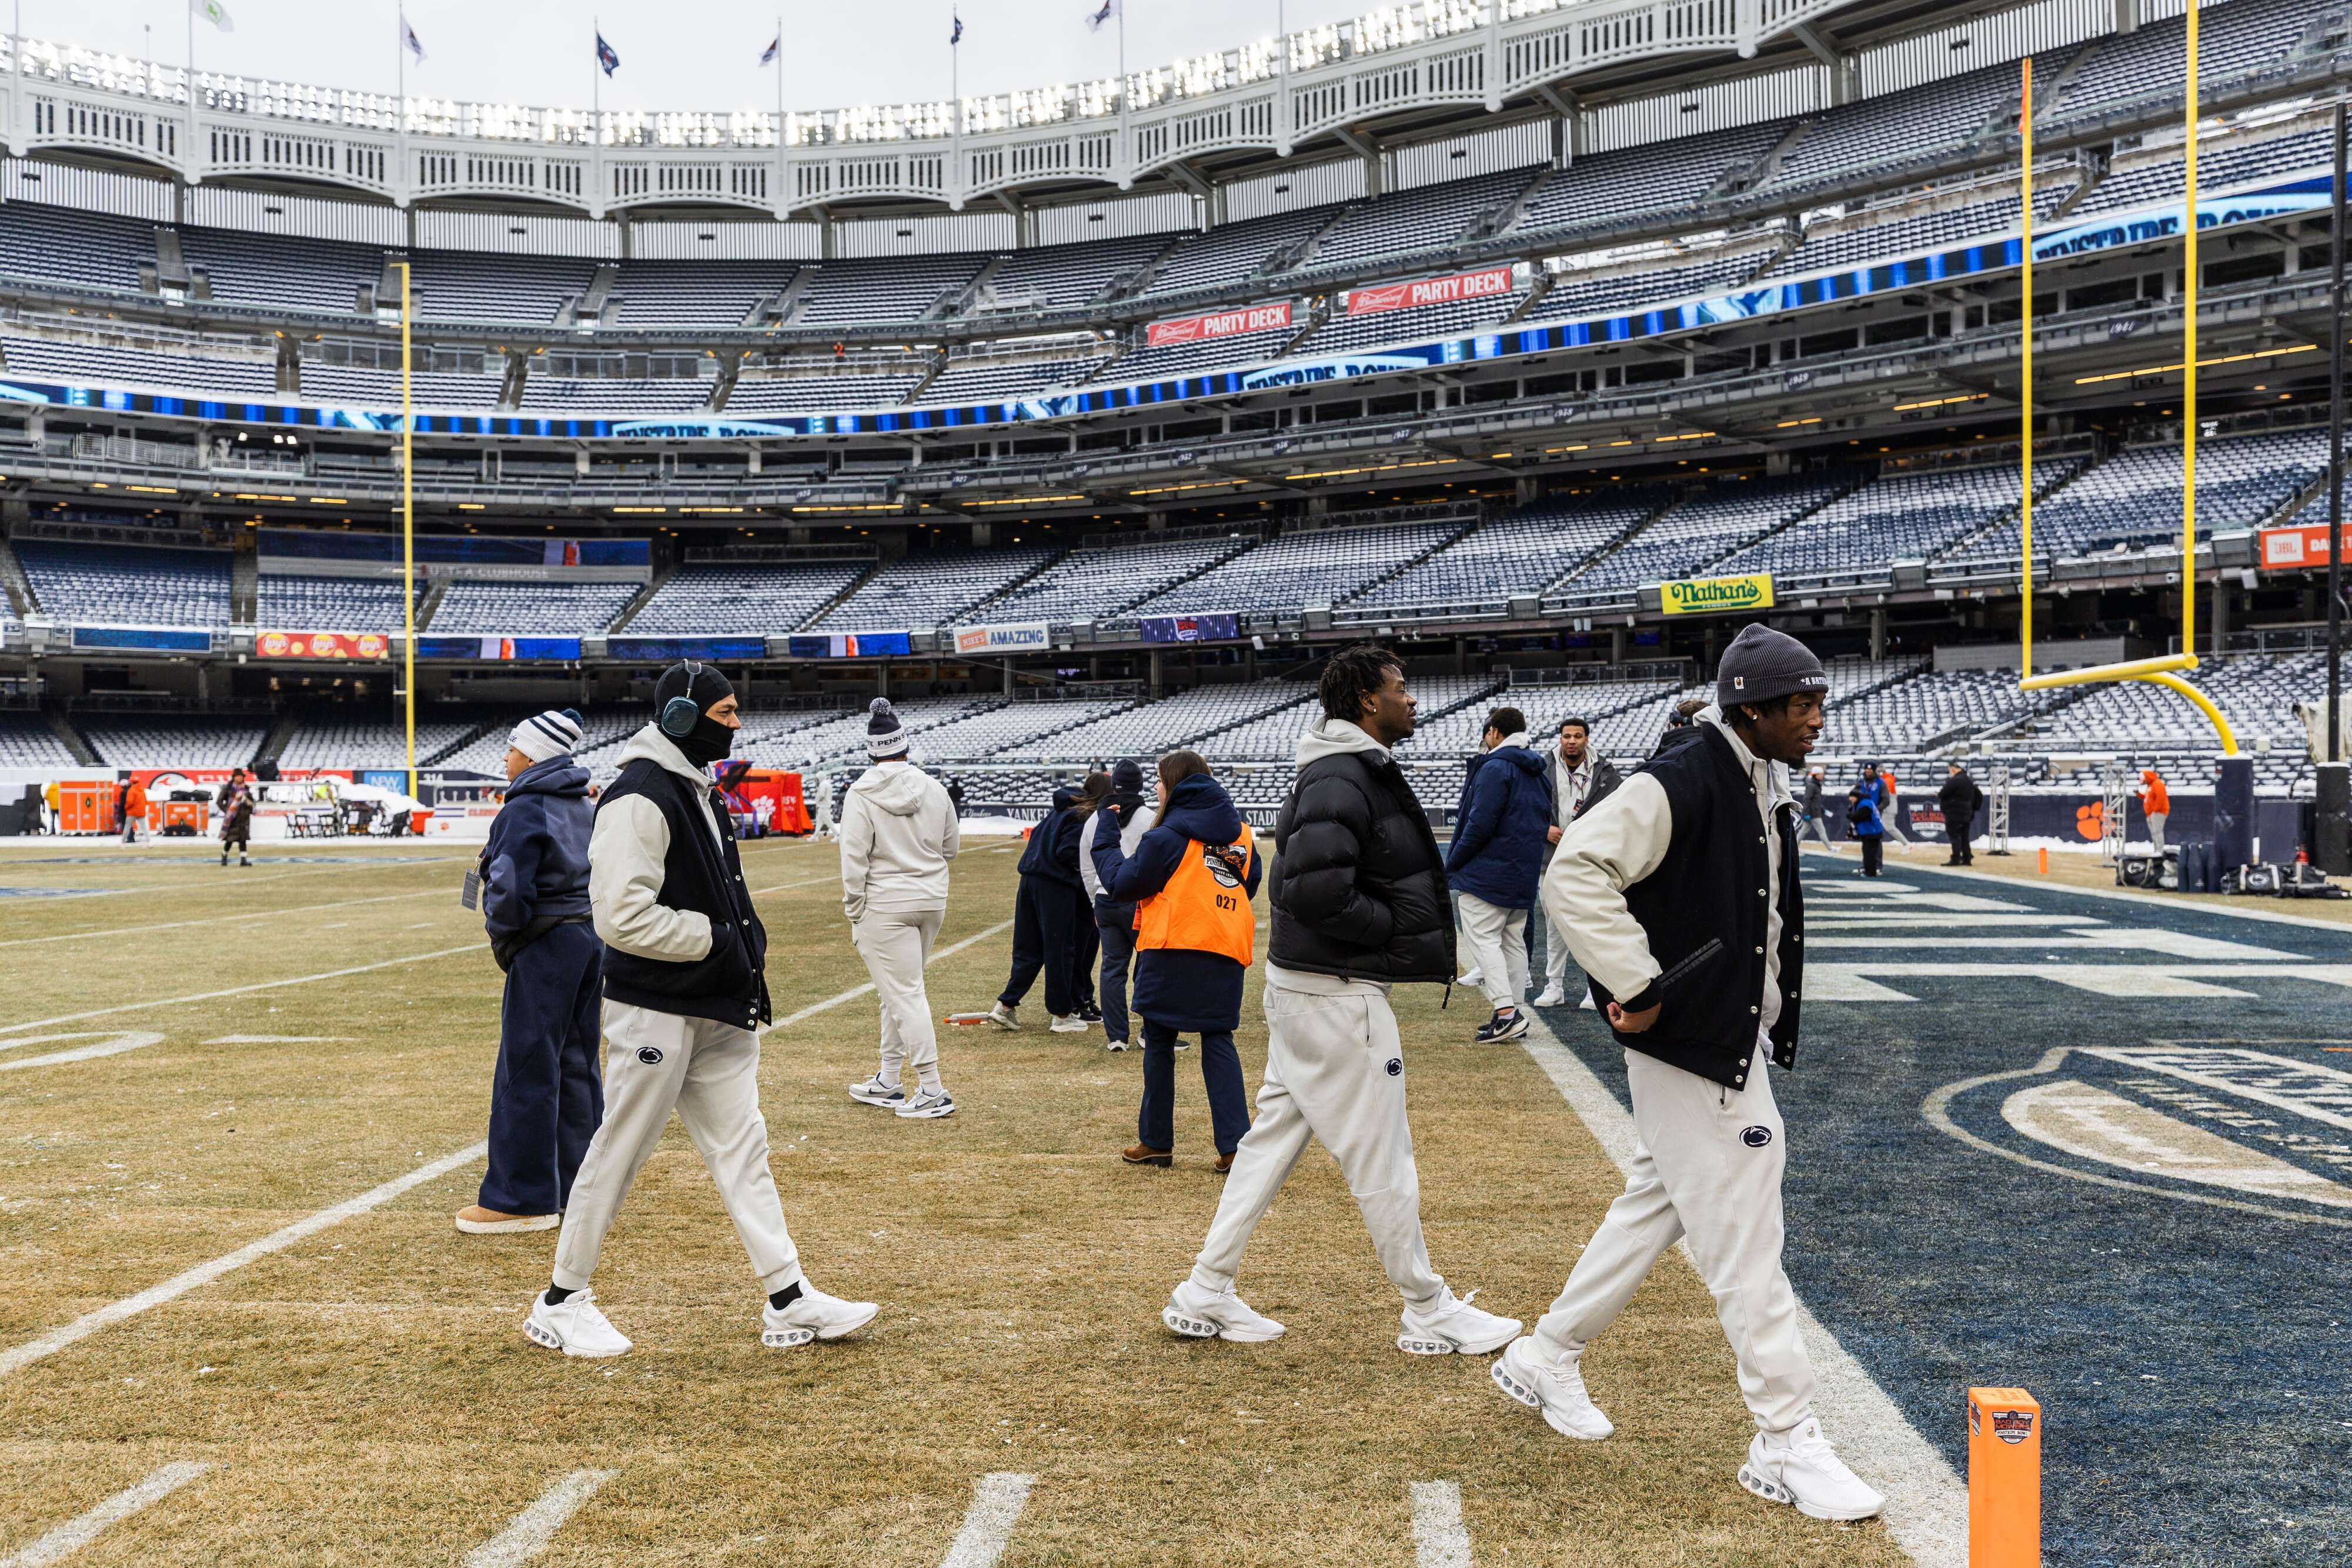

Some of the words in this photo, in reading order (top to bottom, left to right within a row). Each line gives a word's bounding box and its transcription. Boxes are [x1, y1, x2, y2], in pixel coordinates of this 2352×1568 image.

[1412, 279, 1459, 303] PARTY
[1464, 271, 1506, 296] DECK
[1204, 313, 1247, 336] PARTY
[1250, 306, 1287, 328] DECK
[2274, 540, 2297, 555] JBL
[477, 568, 549, 579] CLUBHOUSE
[1671, 579, 1760, 603] Nathan's
[990, 630, 1044, 645] AMAZING
[877, 735, 901, 746] PENN
[1246, 810, 1279, 825] STADI
[1217, 894, 1237, 911] 027
